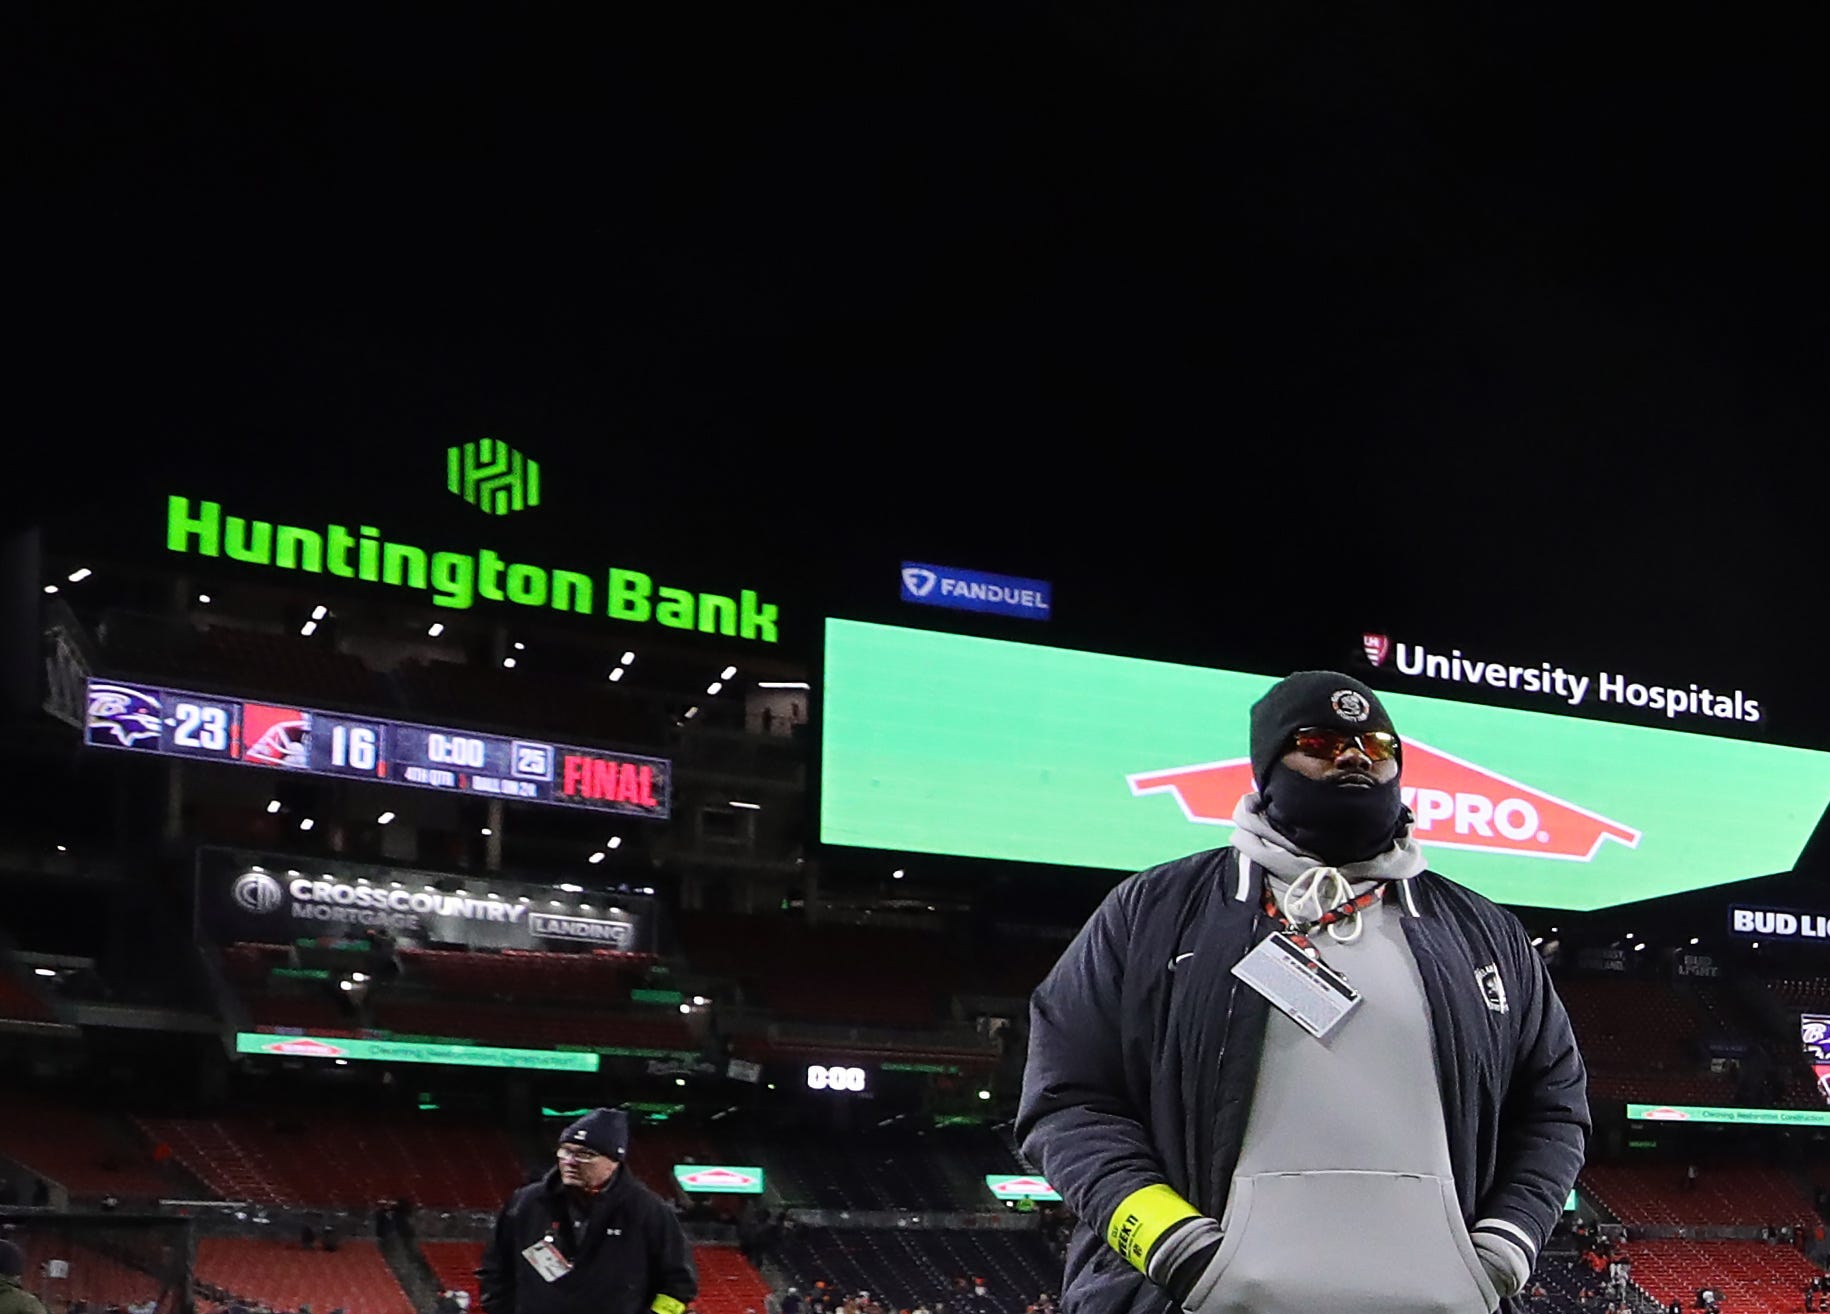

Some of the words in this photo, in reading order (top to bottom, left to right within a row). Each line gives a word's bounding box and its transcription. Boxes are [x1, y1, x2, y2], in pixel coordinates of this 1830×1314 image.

[167, 495, 593, 614] Huntington
[608, 567, 778, 643] Bank
[941, 579, 1049, 608] FANDUEL
[1396, 643, 1589, 704] University
[1600, 672, 1760, 722] Hospitals
[174, 703, 227, 750] 23
[331, 725, 375, 770] 16
[428, 733, 485, 768] 0:00
[518, 748, 546, 774] 25
[563, 756, 658, 807] FINAL
[290, 879, 527, 922] CROSSCOUNTRY
[291, 902, 419, 930] MORTGAGE
[537, 917, 626, 940] LANDING
[1734, 910, 1797, 936] BUD
[807, 1065, 866, 1091] 0:00
